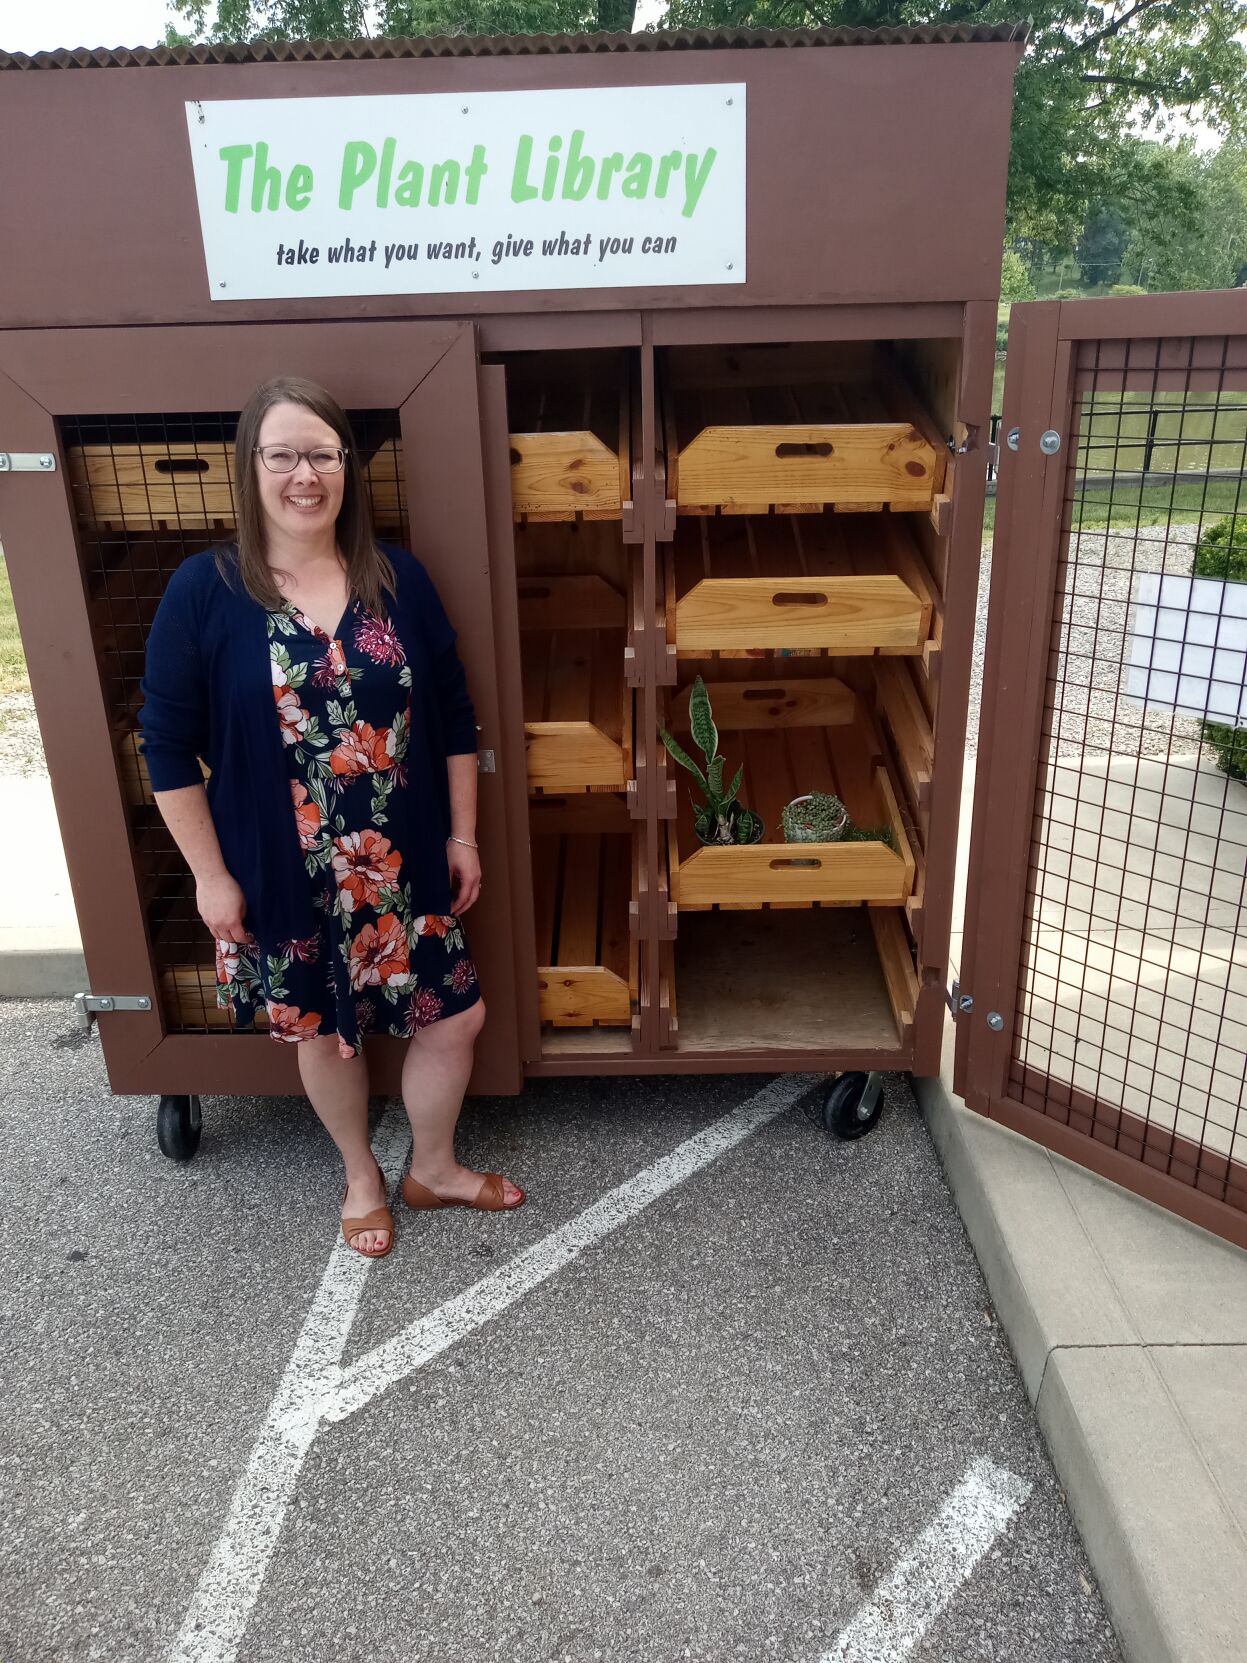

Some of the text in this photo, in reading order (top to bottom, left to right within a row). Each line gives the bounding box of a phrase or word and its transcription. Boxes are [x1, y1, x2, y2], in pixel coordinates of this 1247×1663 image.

[218, 129, 717, 219] The Plant Library
[277, 231, 677, 269] take what you want, give what you can
